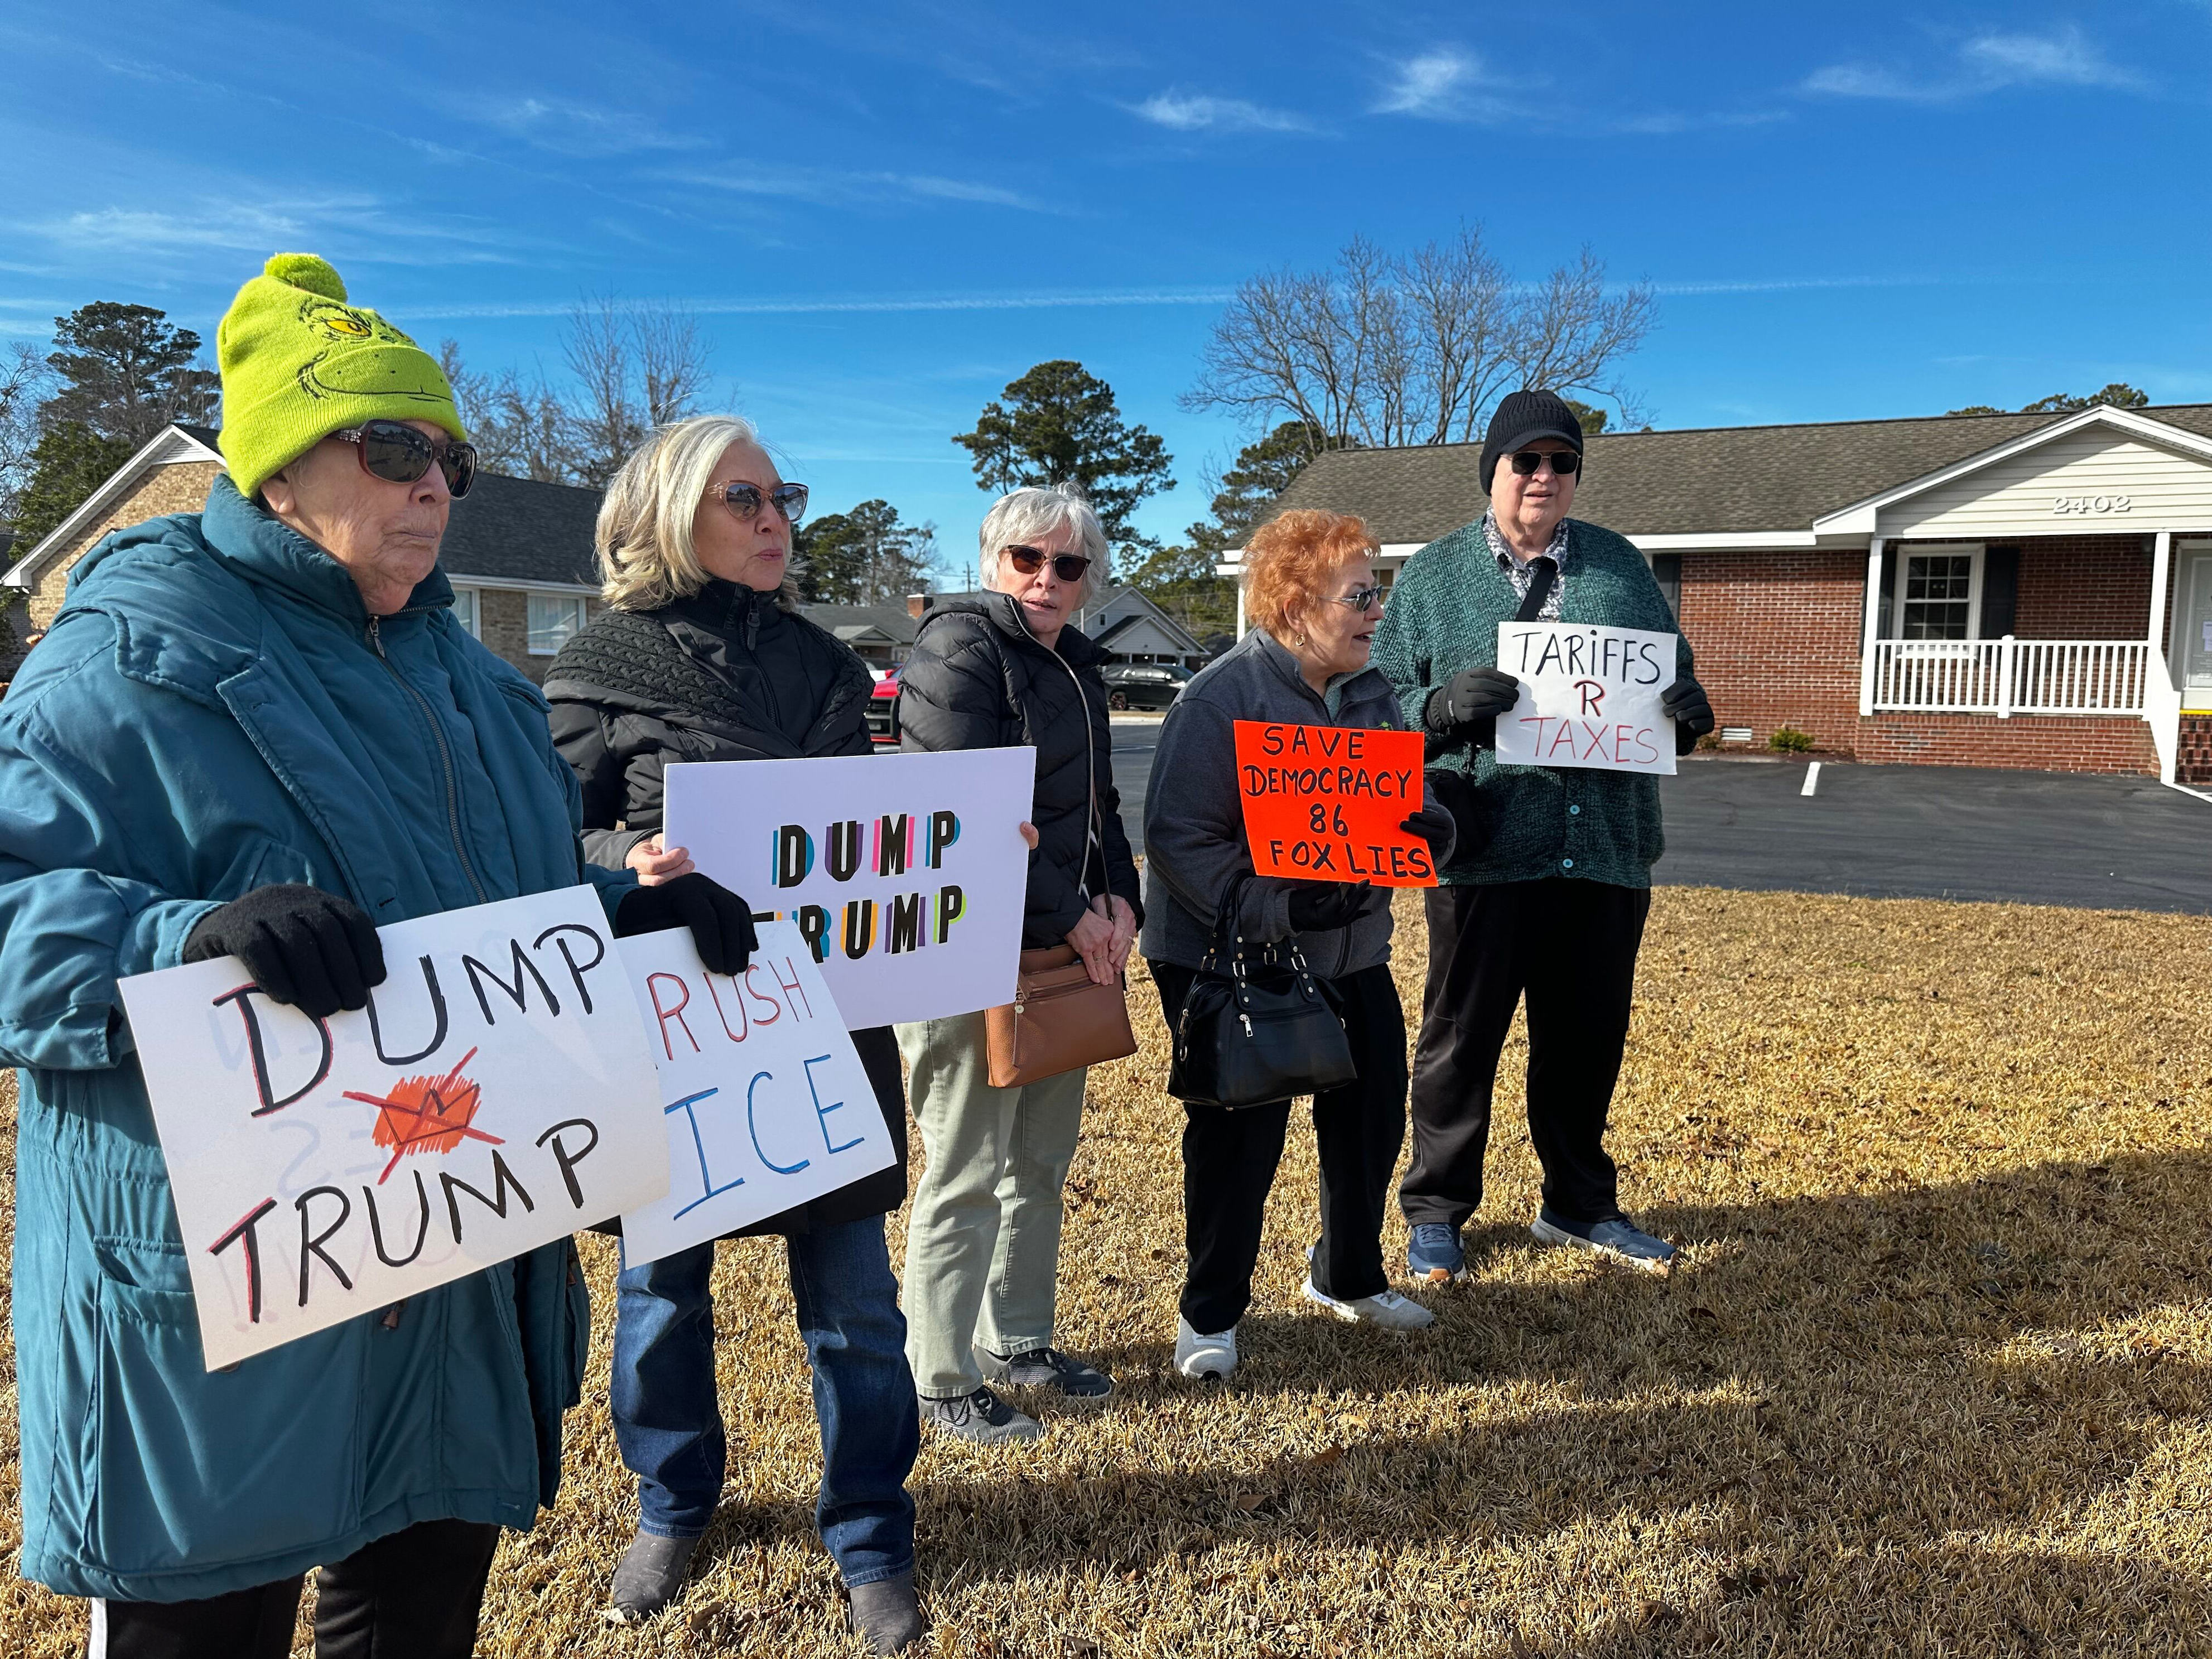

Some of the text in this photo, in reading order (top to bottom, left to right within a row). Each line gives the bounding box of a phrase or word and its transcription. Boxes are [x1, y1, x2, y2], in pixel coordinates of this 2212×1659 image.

[2053, 495, 2131, 514] 2402
[1573, 679, 1606, 717] R
[1262, 726, 1365, 759] SAVE
[1519, 716, 1659, 764] TAXES
[1243, 765, 1412, 799] DEMOCRACY
[1310, 803, 1348, 837] 86
[772, 810, 960, 889] DUMP
[1269, 840, 1431, 878] FOX LIES
[751, 885, 967, 963] RUMP
[213, 923, 605, 1118] DUMP
[647, 956, 812, 1063] RUSH
[664, 1054, 865, 1221] ICE
[208, 1118, 599, 1323] TRUMP
